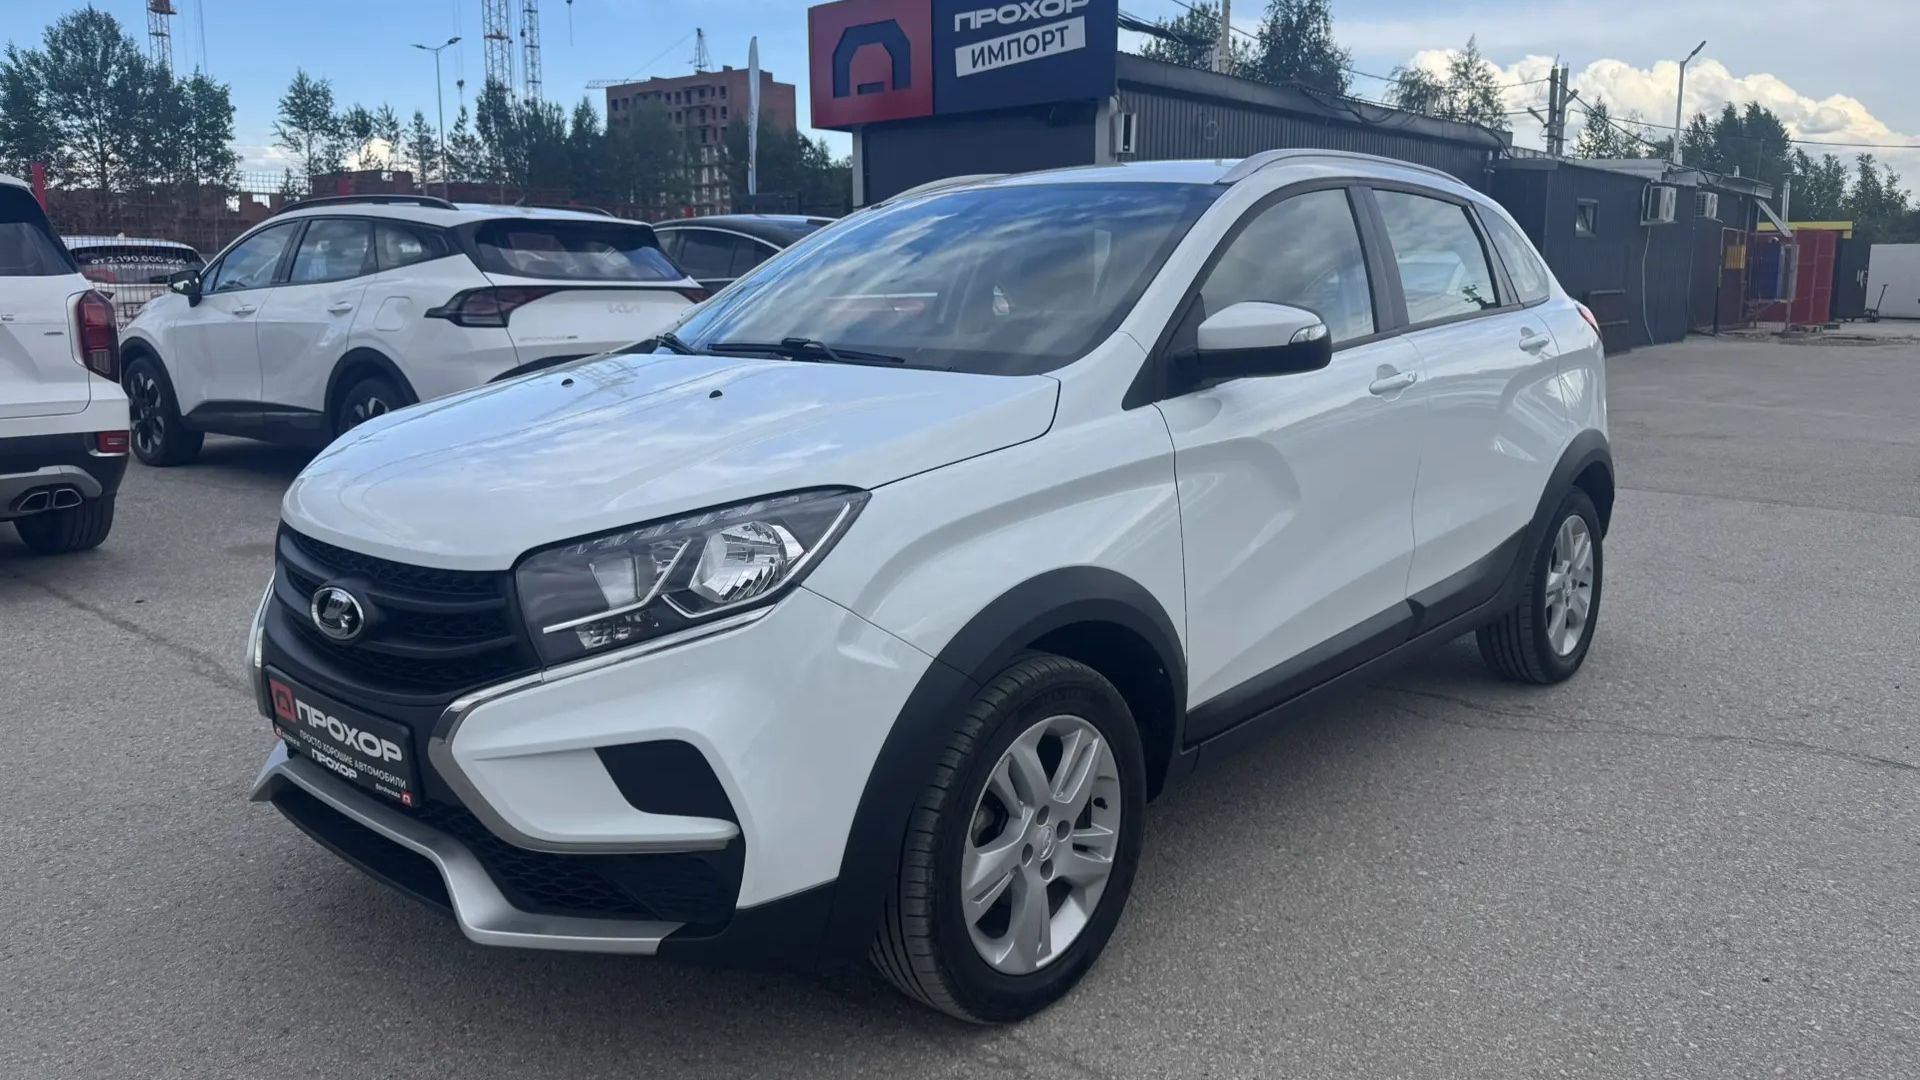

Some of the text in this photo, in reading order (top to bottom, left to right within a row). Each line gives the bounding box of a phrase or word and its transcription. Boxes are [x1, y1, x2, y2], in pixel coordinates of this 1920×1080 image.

[954, 0, 1089, 32] ПРОХОР
[971, 25, 1069, 69] ИМПОРТ
[295, 698, 402, 762] ПРОХОР
[300, 729, 321, 749] ПРОСТО
[320, 741, 353, 767] ХОРОШИЕ
[354, 759, 407, 790] АВТОМОБИЛИ
[312, 748, 358, 779] ПРОХОР
